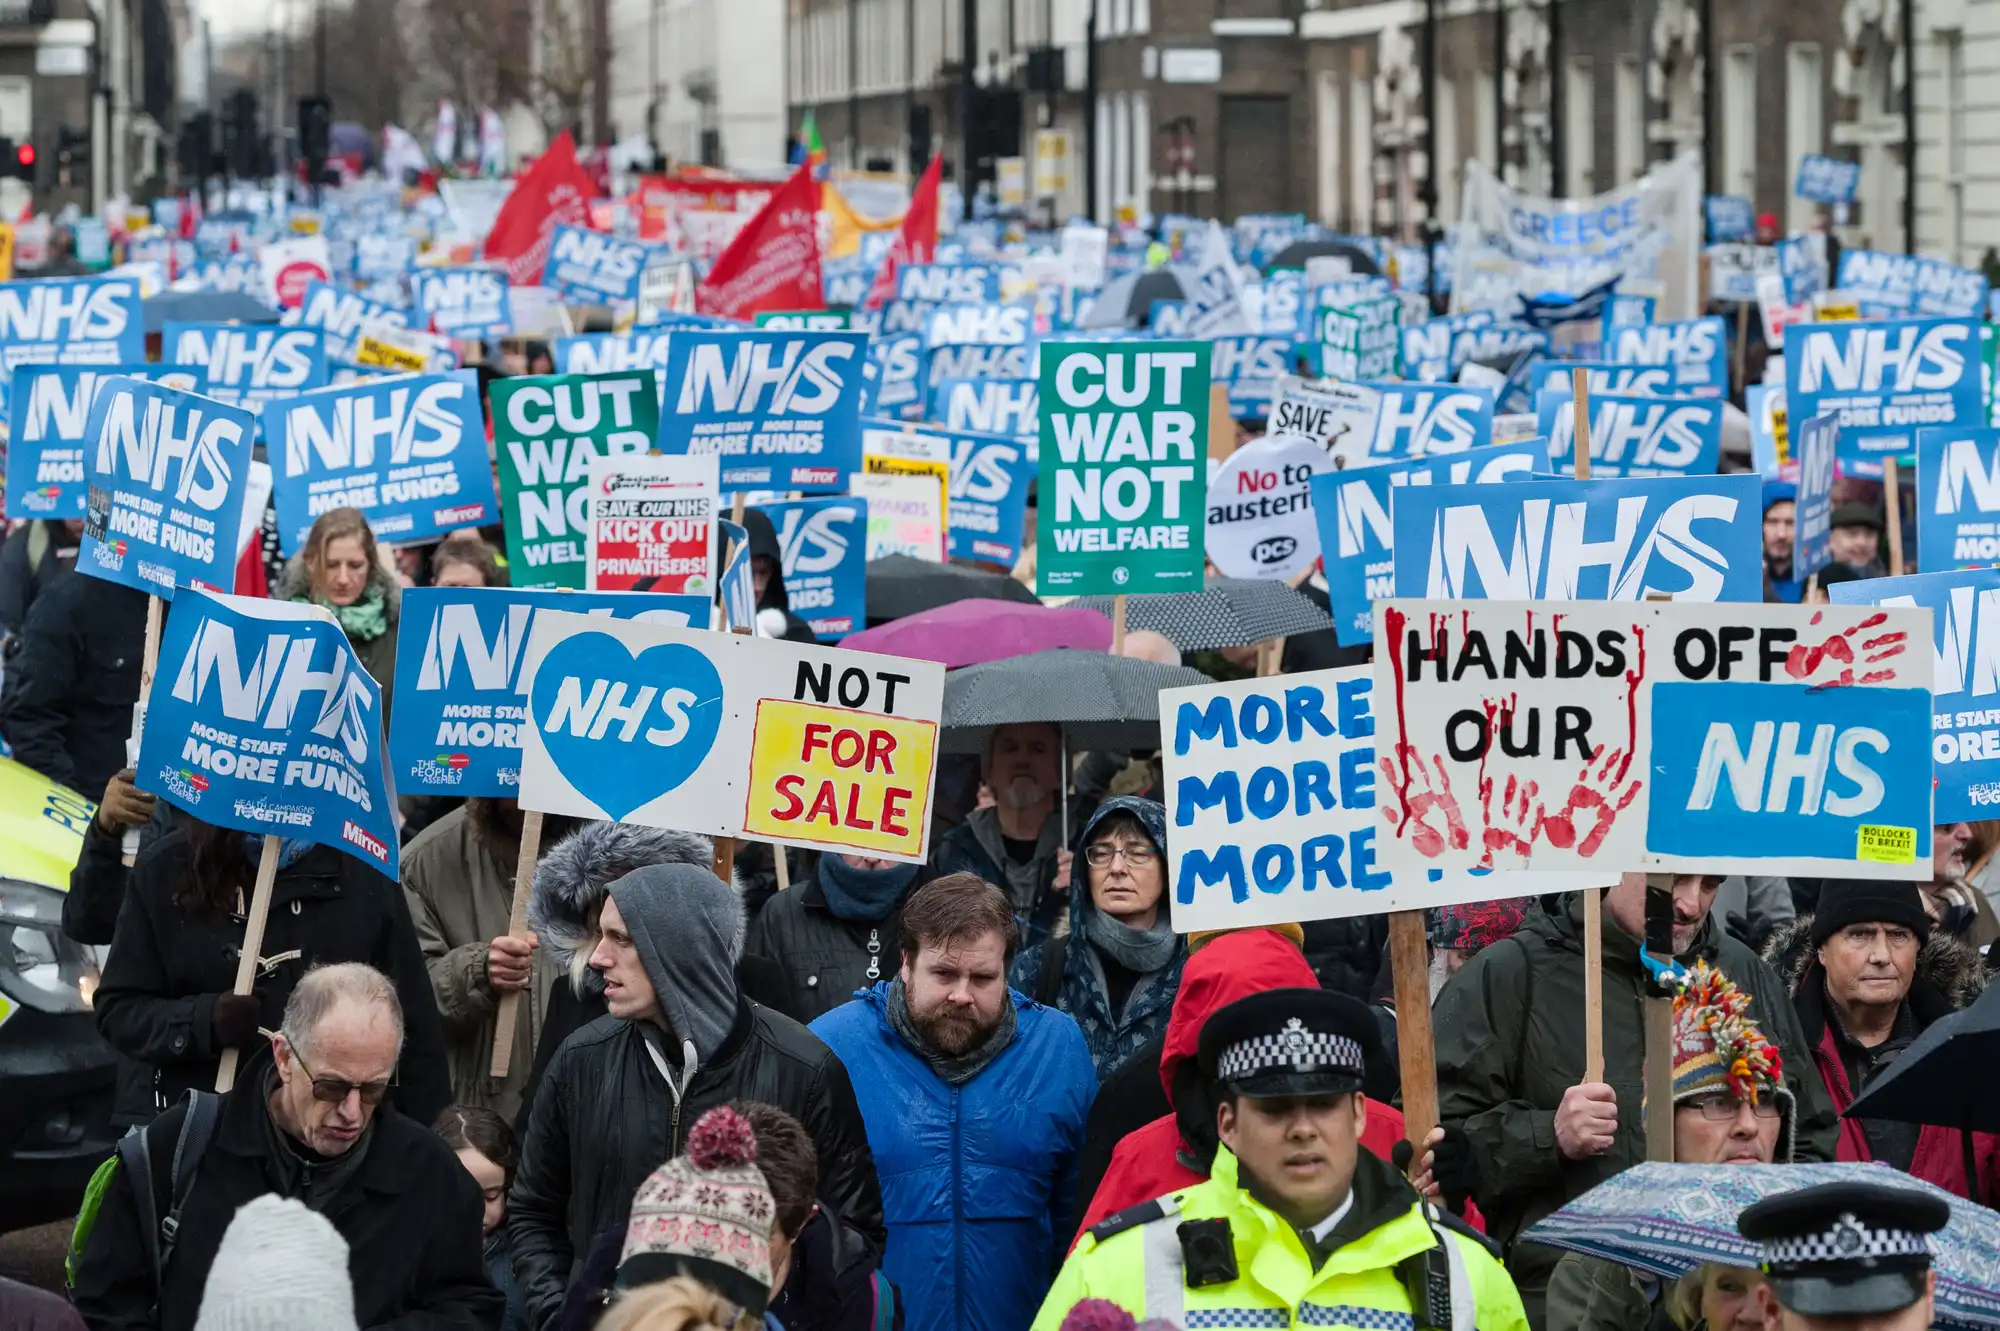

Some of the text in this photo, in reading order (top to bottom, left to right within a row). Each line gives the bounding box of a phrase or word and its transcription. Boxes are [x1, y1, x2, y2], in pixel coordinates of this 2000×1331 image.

[1510, 197, 1640, 244] GREECE
[554, 230, 646, 274] NHS
[424, 271, 503, 311] NHS
[902, 267, 987, 300] NHS
[0, 283, 132, 341] NHS
[930, 306, 1029, 346] NHS
[176, 330, 317, 387] NHS
[1618, 321, 1720, 365] NHS
[1799, 324, 1969, 392] NHS
[676, 340, 856, 417] NHS
[1056, 352, 1197, 408] CUT
[507, 377, 642, 437] CUT
[1277, 402, 1332, 436] SAVE
[1374, 392, 1483, 456] HS
[1883, 404, 1956, 424] FUNDS
[95, 391, 243, 511] NHS
[286, 382, 464, 478] NHS
[686, 433, 824, 455] MORE FUNDS
[1051, 411, 1196, 463] WAR
[1548, 402, 1711, 467] NHS
[308, 473, 460, 516] MORE FUNDS
[791, 468, 837, 484] Mirror
[1055, 466, 1194, 522] NOT
[1237, 463, 1312, 495] No to
[114, 490, 164, 517] MORE STAFF
[434, 506, 484, 527] Mirror
[597, 498, 710, 517] SAVE OUR NHS
[1208, 485, 1312, 525] austeri
[109, 506, 215, 564] MORE FUNDS
[599, 520, 707, 543] KICK OUT
[637, 543, 671, 558] THE
[1053, 525, 1190, 553] WELFARE
[1254, 537, 1295, 563] pcs
[1425, 494, 1740, 601] NHS
[597, 557, 707, 575] PRIVATISERS!
[788, 587, 835, 612] NDS
[1407, 626, 1798, 682] HANDS OFF
[171, 615, 373, 764] NHS
[794, 661, 911, 714] NOT
[442, 704, 527, 719] MORE STA
[544, 675, 697, 747] NHS
[1175, 677, 1376, 756] MORE
[1933, 713, 1953, 730] RE
[190, 720, 288, 757] MORE STAFF
[801, 723, 897, 775] FOR
[1445, 705, 1595, 763] OUR
[1932, 730, 2000, 764] ORE
[164, 765, 181, 779] THE
[181, 737, 281, 784] MORE
[284, 760, 373, 813] FUNDS
[416, 760, 436, 769] THE
[1686, 720, 1892, 818] NHS
[234, 798, 315, 815] HEALTH CAMPAIGNS
[770, 773, 912, 837] SALE
[1175, 748, 1377, 827] MORE
[233, 804, 313, 827] TOGETHER
[1864, 827, 1911, 840] BOLLOCKS
[343, 820, 388, 862] Mirror
[1863, 836, 1910, 849] TO BREXIT
[1176, 826, 1393, 905] MORE
